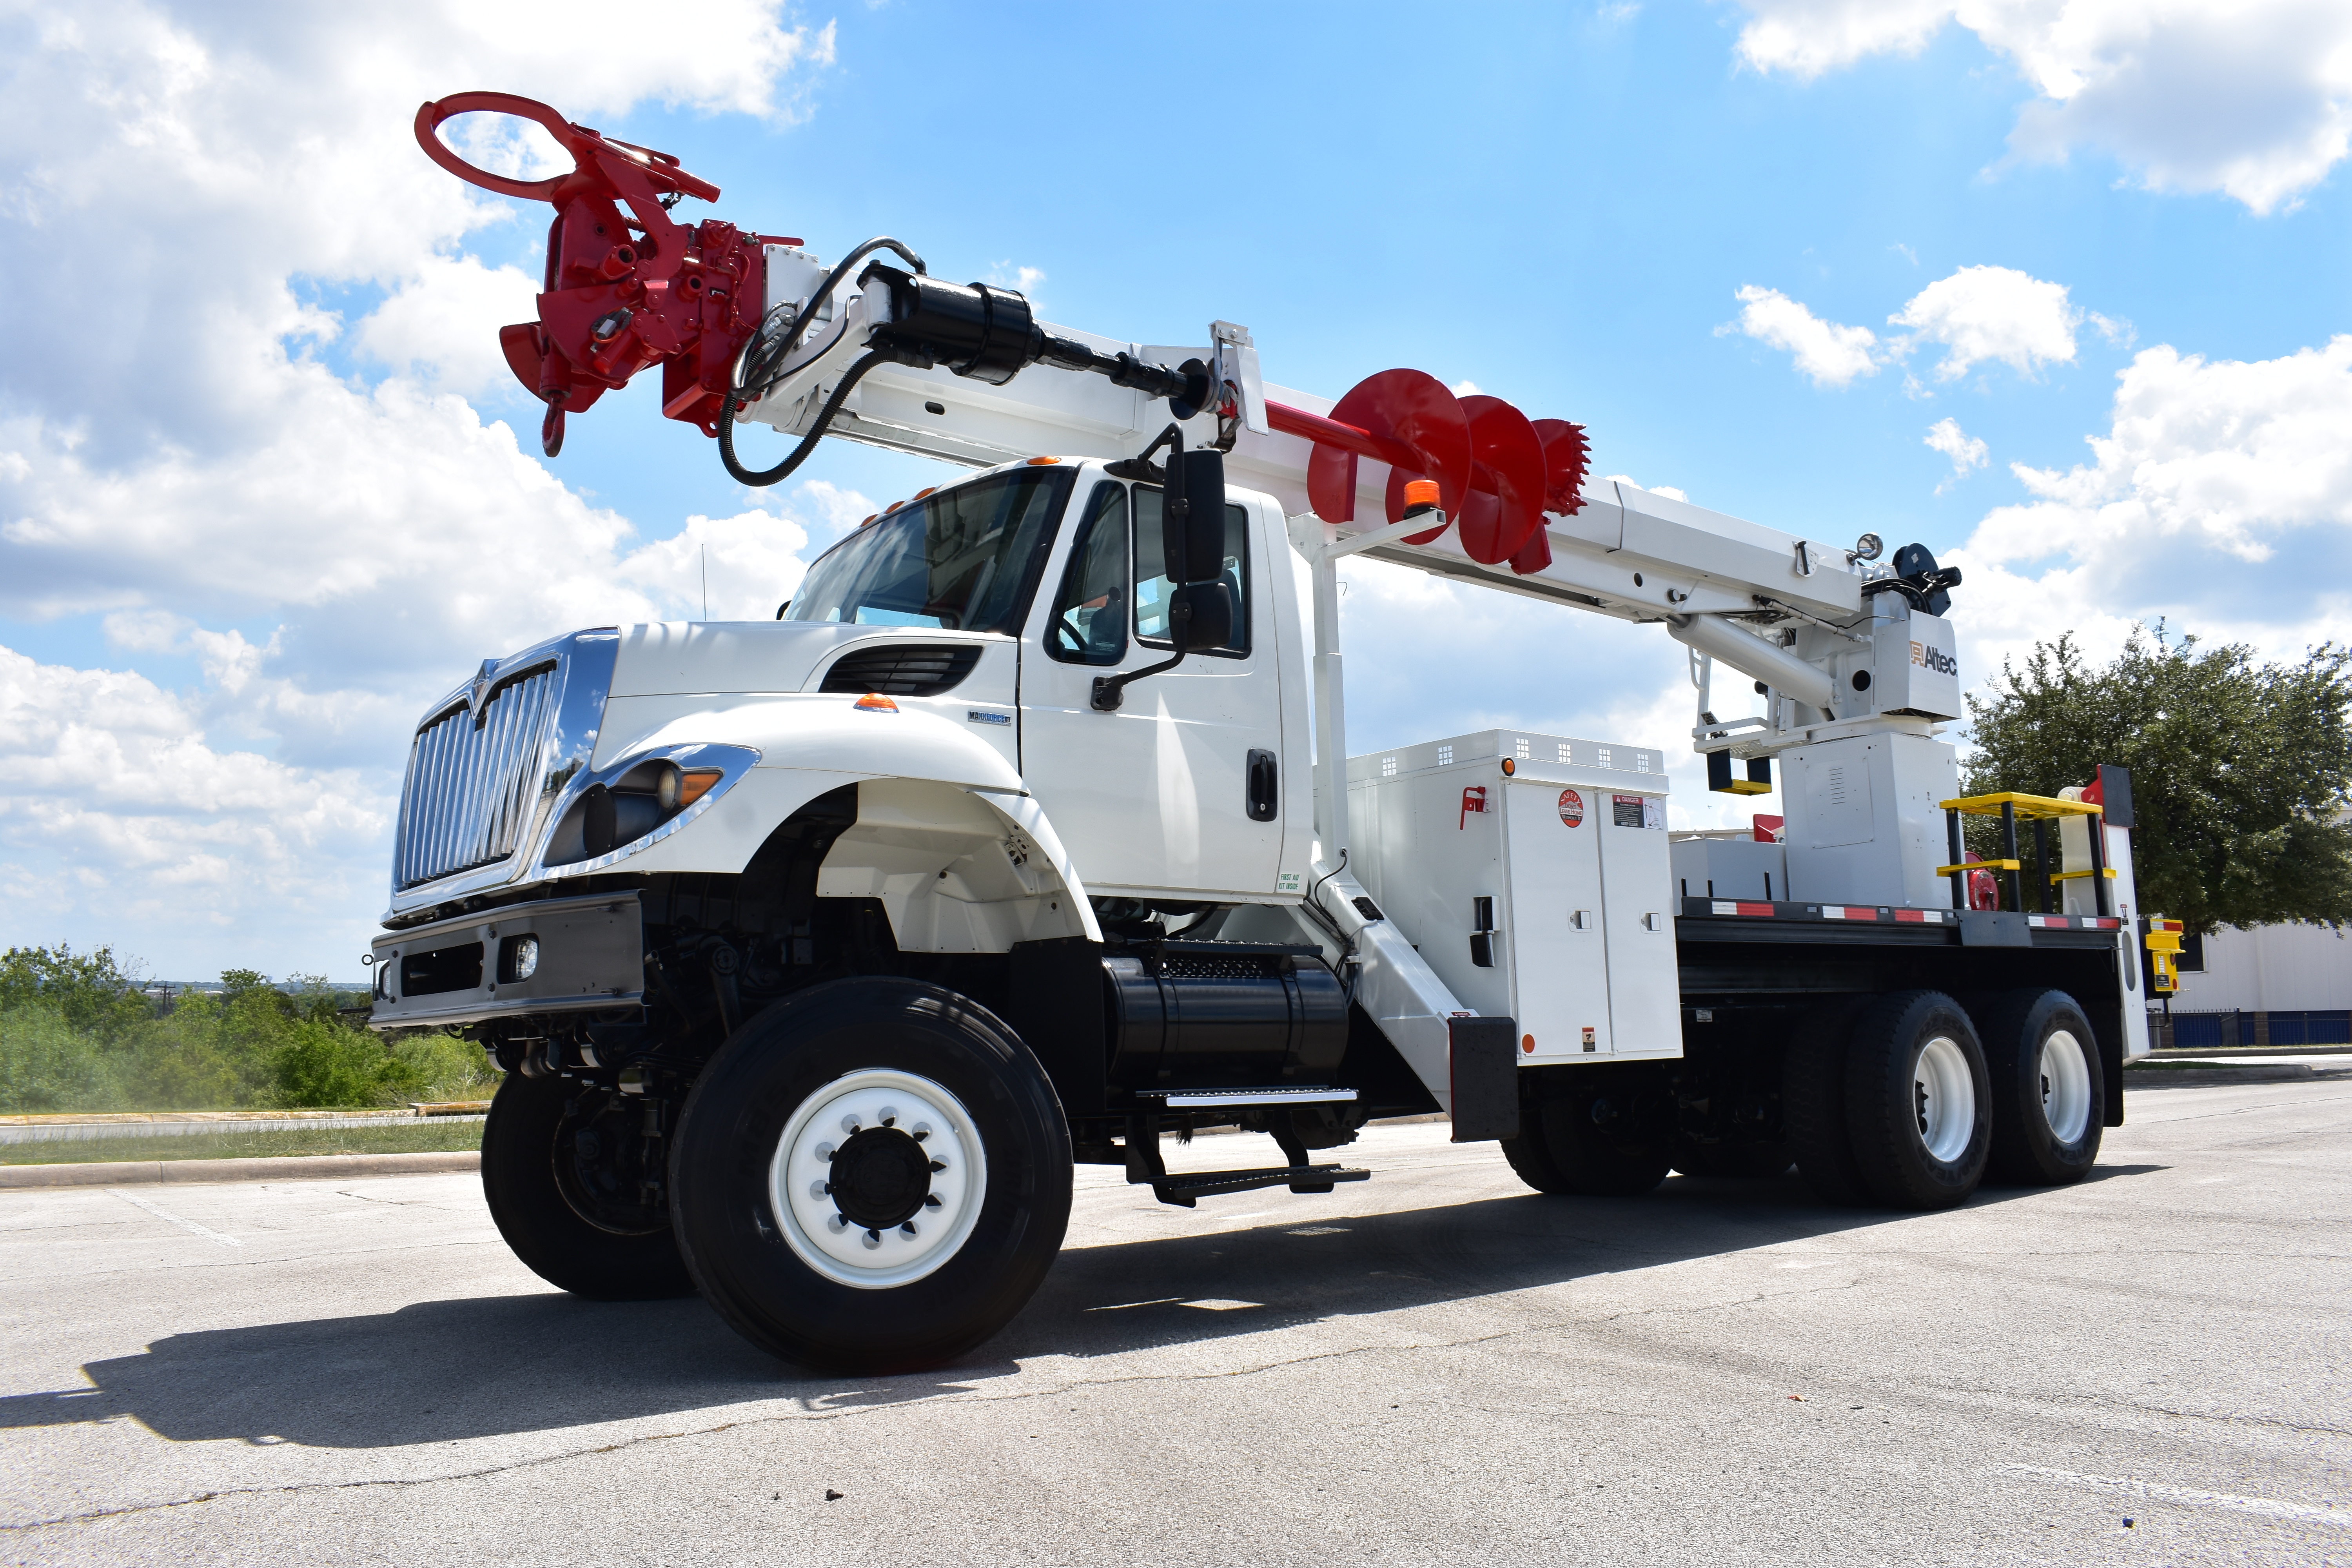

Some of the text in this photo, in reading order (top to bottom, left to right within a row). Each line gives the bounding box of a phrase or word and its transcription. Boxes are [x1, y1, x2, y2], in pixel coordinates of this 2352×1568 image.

[1924, 645, 1957, 676] Altec
[1561, 792, 1581, 803] SAFETY
[1914, 1016, 1965, 1049] G622 RSD
[2051, 1091, 2100, 1160] GOODYEAR
[1917, 1122, 1985, 1182] GOODYEAR
